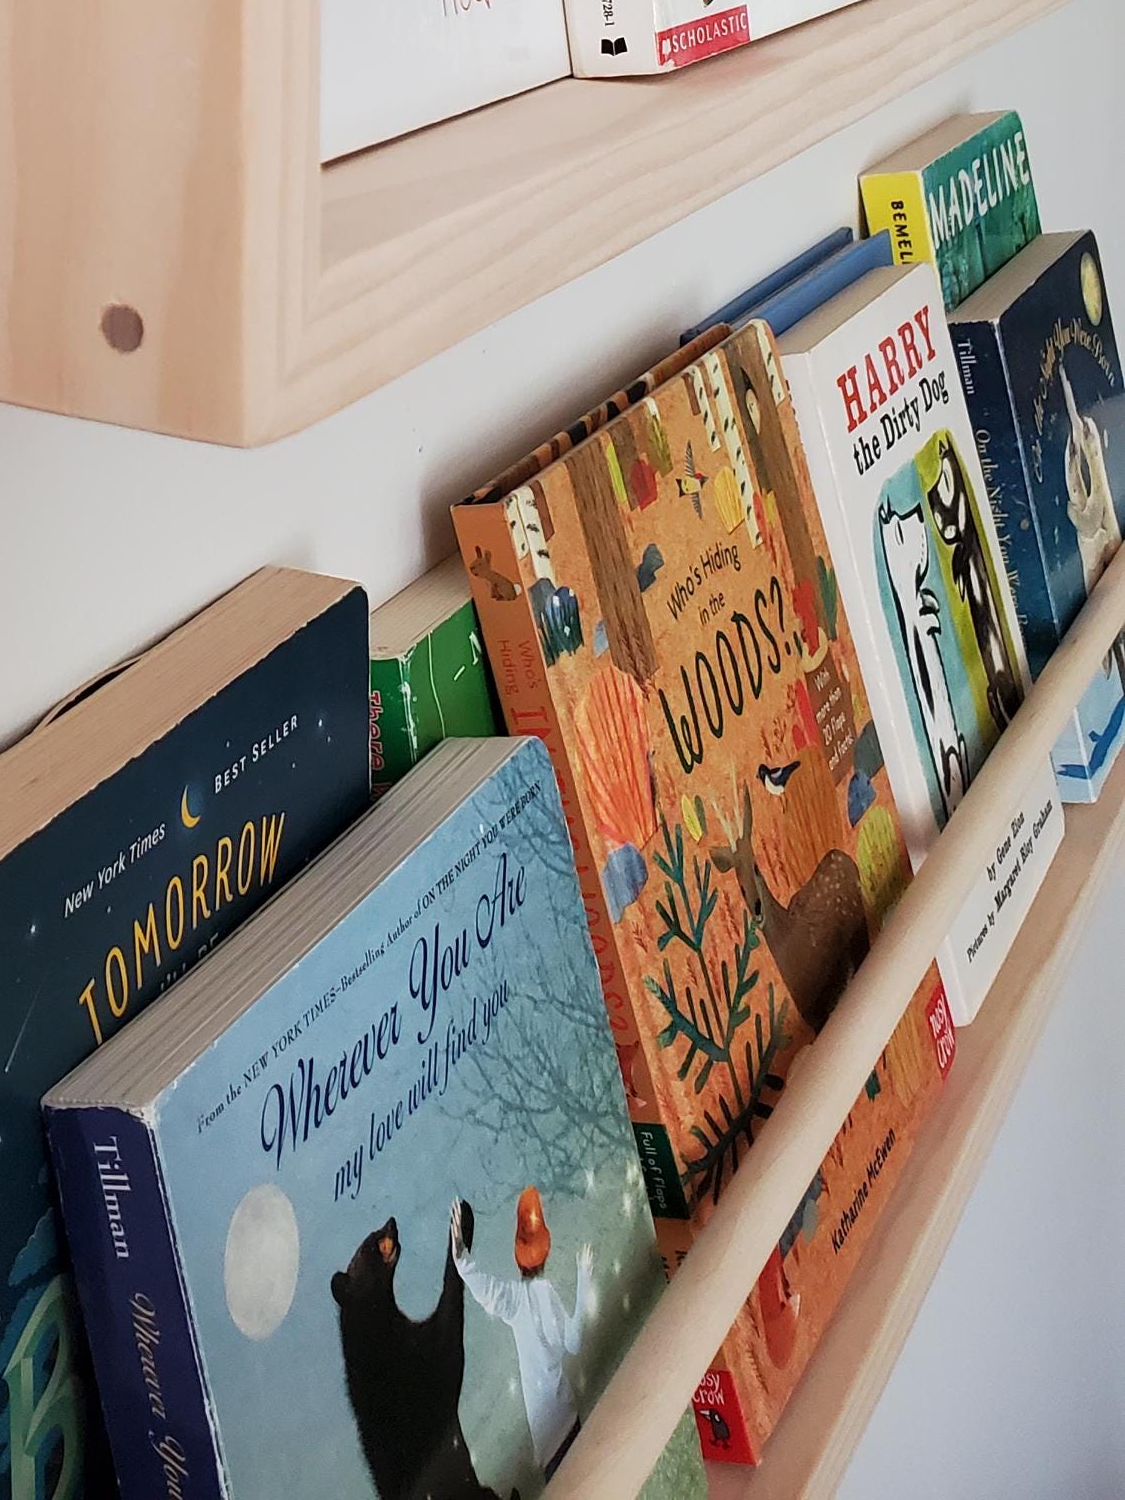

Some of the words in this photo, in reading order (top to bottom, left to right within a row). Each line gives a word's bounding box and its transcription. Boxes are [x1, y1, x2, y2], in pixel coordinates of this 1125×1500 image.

[672, 11, 749, 53] SCHOLASTIC
[928, 131, 1032, 250] MADELINE
[837, 305, 939, 433] HARRY
[956, 338, 975, 395] Tillman
[853, 435, 880, 476] the
[879, 396, 922, 451] Dirty
[918, 369, 950, 408] Dog
[975, 428, 992, 454] On
[979, 457, 999, 482] the
[987, 485, 1009, 530] Night
[666, 562, 704, 623] Who's
[700, 542, 742, 583] Hiding
[698, 604, 709, 625] in
[708, 591, 726, 619] the
[500, 639, 520, 696] Hiding
[518, 640, 538, 690] Who's
[816, 701, 831, 725] more
[829, 686, 842, 708] than
[823, 723, 833, 746] 20
[829, 745, 840, 772] and
[63, 881, 94, 919] New
[96, 850, 127, 890] York
[129, 821, 167, 865] Times
[214, 754, 247, 794] BEST
[252, 714, 299, 763] SELLER
[986, 861, 996, 882] by
[996, 836, 1014, 864] Gene
[1009, 811, 1025, 842] Zion
[966, 922, 988, 963] Pictures
[987, 911, 996, 927] by
[993, 857, 1022, 913] Margaret
[1018, 836, 1034, 864] Bloy
[1031, 799, 1054, 840] Graham
[78, 812, 286, 1046] TOMORROW
[196, 1102, 225, 1135] From
[225, 1083, 243, 1108] the
[242, 1052, 270, 1088] NEW
[271, 1023, 305, 1060] YORK
[385, 914, 414, 950] Author
[413, 901, 424, 920] of
[421, 887, 438, 911] ON
[435, 869, 457, 897] THE
[455, 845, 483, 880] NIGHT
[481, 825, 500, 851] YOU
[498, 804, 523, 833] WERE
[519, 780, 543, 812] BORN
[260, 1001, 403, 1171] Wherever
[408, 923, 472, 1045] You
[475, 852, 528, 949] Are
[333, 1142, 365, 1202] my
[368, 1099, 405, 1161] love
[407, 1048, 440, 1116] will
[437, 995, 478, 1098] find
[479, 979, 510, 1045] you
[640, 1131, 658, 1155] Full
[647, 1158, 662, 1175] of
[93, 1136, 132, 1260] Tillman
[830, 1184, 870, 1255] Katharine
[866, 1127, 897, 1199] McEwen
[129, 1292, 166, 1421] Wherever
